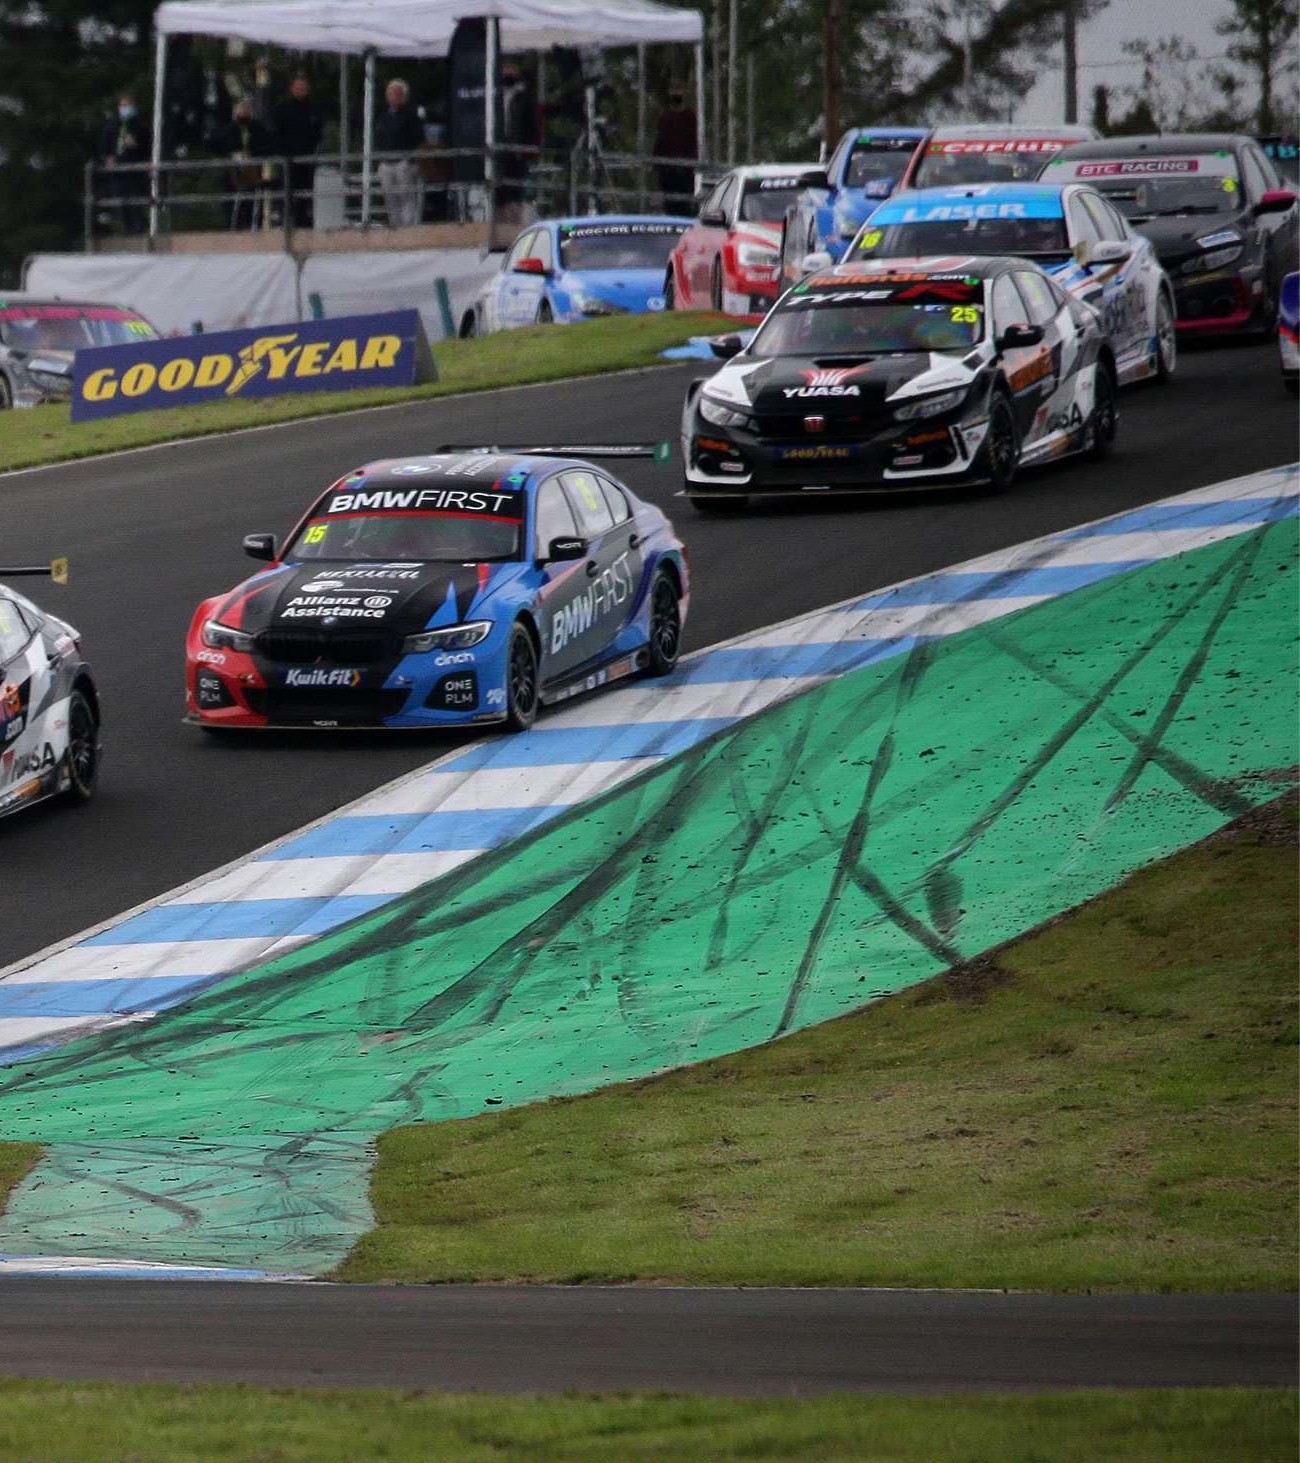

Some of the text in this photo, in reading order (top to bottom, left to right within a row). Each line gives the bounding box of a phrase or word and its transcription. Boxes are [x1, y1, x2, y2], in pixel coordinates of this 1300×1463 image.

[1081, 161, 1189, 176] BTC RACING
[902, 203, 1027, 222] LASER
[786, 283, 975, 306] TYPE R
[951, 306, 978, 323] 25
[82, 335, 402, 401] GOODYEAR
[783, 385, 861, 398] YUASA
[302, 524, 329, 545] 15
[287, 596, 362, 607] Allianz
[280, 606, 386, 619] Assistance
[434, 652, 476, 666] cinch
[445, 678, 473, 691] ONE
[445, 693, 474, 704] PLM
